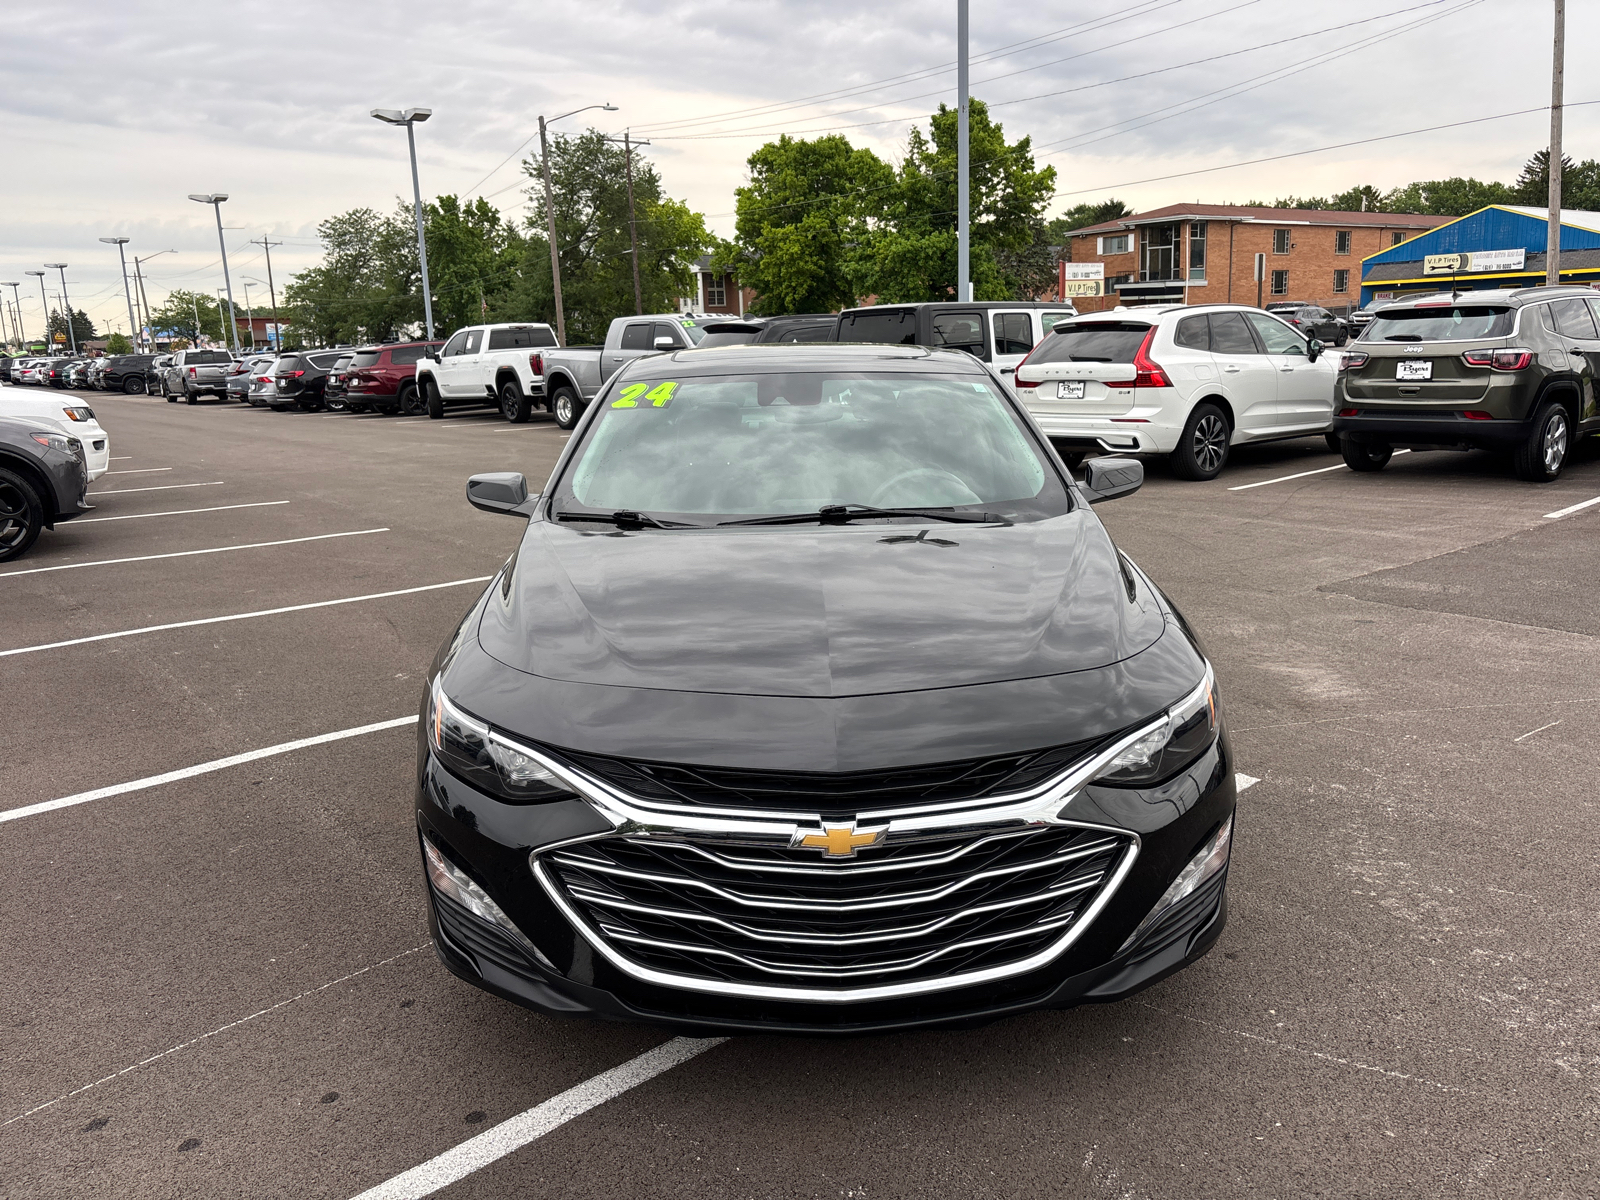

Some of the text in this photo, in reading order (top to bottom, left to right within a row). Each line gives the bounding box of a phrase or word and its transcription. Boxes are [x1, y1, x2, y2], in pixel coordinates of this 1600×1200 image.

[1082, 283, 1097, 292] Tires
[1403, 345, 1424, 354] Jeep
[1400, 364, 1429, 374] Byers
[611, 381, 679, 408] 24
